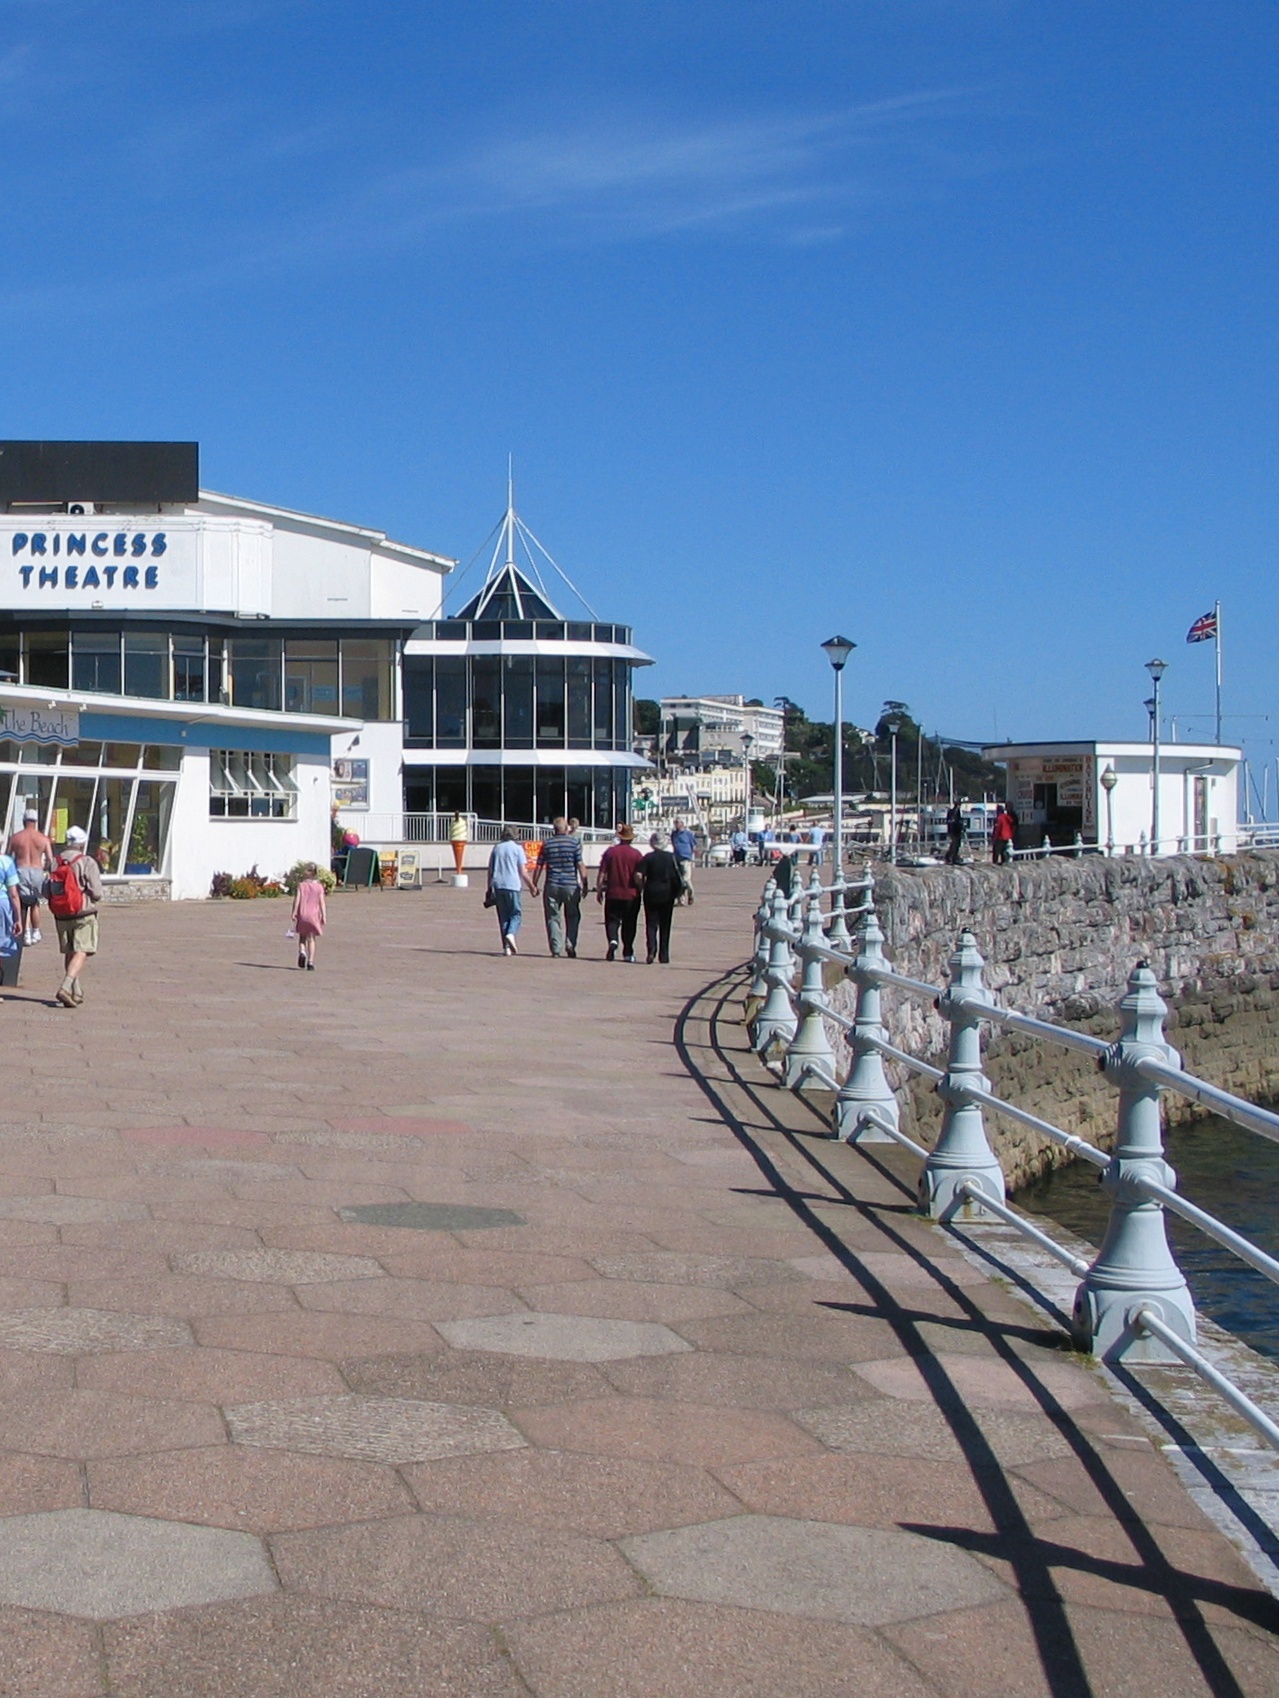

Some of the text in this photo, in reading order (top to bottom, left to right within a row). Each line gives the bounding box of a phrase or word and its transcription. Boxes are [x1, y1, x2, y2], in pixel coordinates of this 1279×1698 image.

[12, 532, 167, 557] PRINCESS
[19, 565, 159, 590] THEATRE
[3, 708, 70, 737] The Beach
